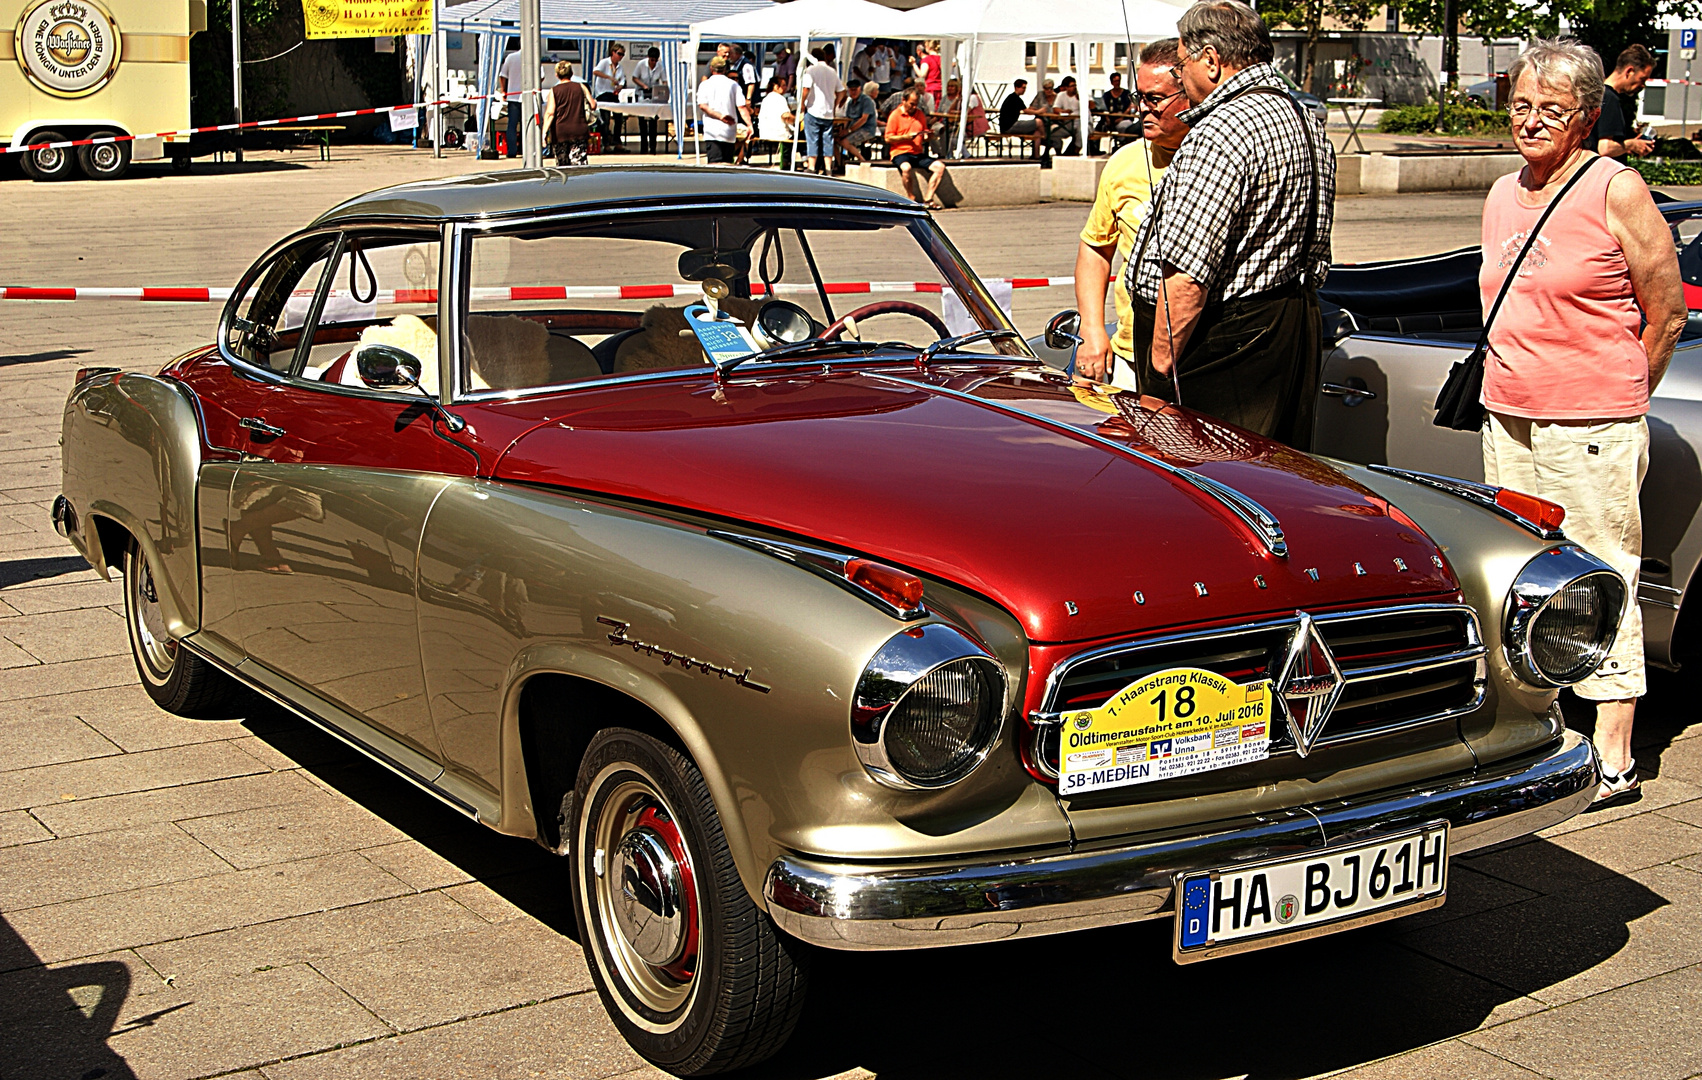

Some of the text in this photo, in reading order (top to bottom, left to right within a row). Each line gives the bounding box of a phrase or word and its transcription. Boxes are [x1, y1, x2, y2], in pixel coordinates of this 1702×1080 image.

[344, 7, 430, 19] Holzwickede
[35, 19, 103, 78] EINE KÖNIGIN UNTER DEN BIEREN
[1683, 31, 1694, 46] P
[1108, 671, 1228, 717] 7. Haarstrang Klassik
[1247, 682, 1264, 692] ADAC
[1150, 685, 1196, 722] 18
[1069, 702, 1264, 748] Oldtimerausfahrt am 10. Juli 2016
[1175, 731, 1212, 745] Volksbank
[1174, 745, 1195, 755] Unna
[1067, 763, 1150, 789] SB-MEDIEN
[1211, 873, 1272, 933] HA
[1189, 918, 1200, 934] D
